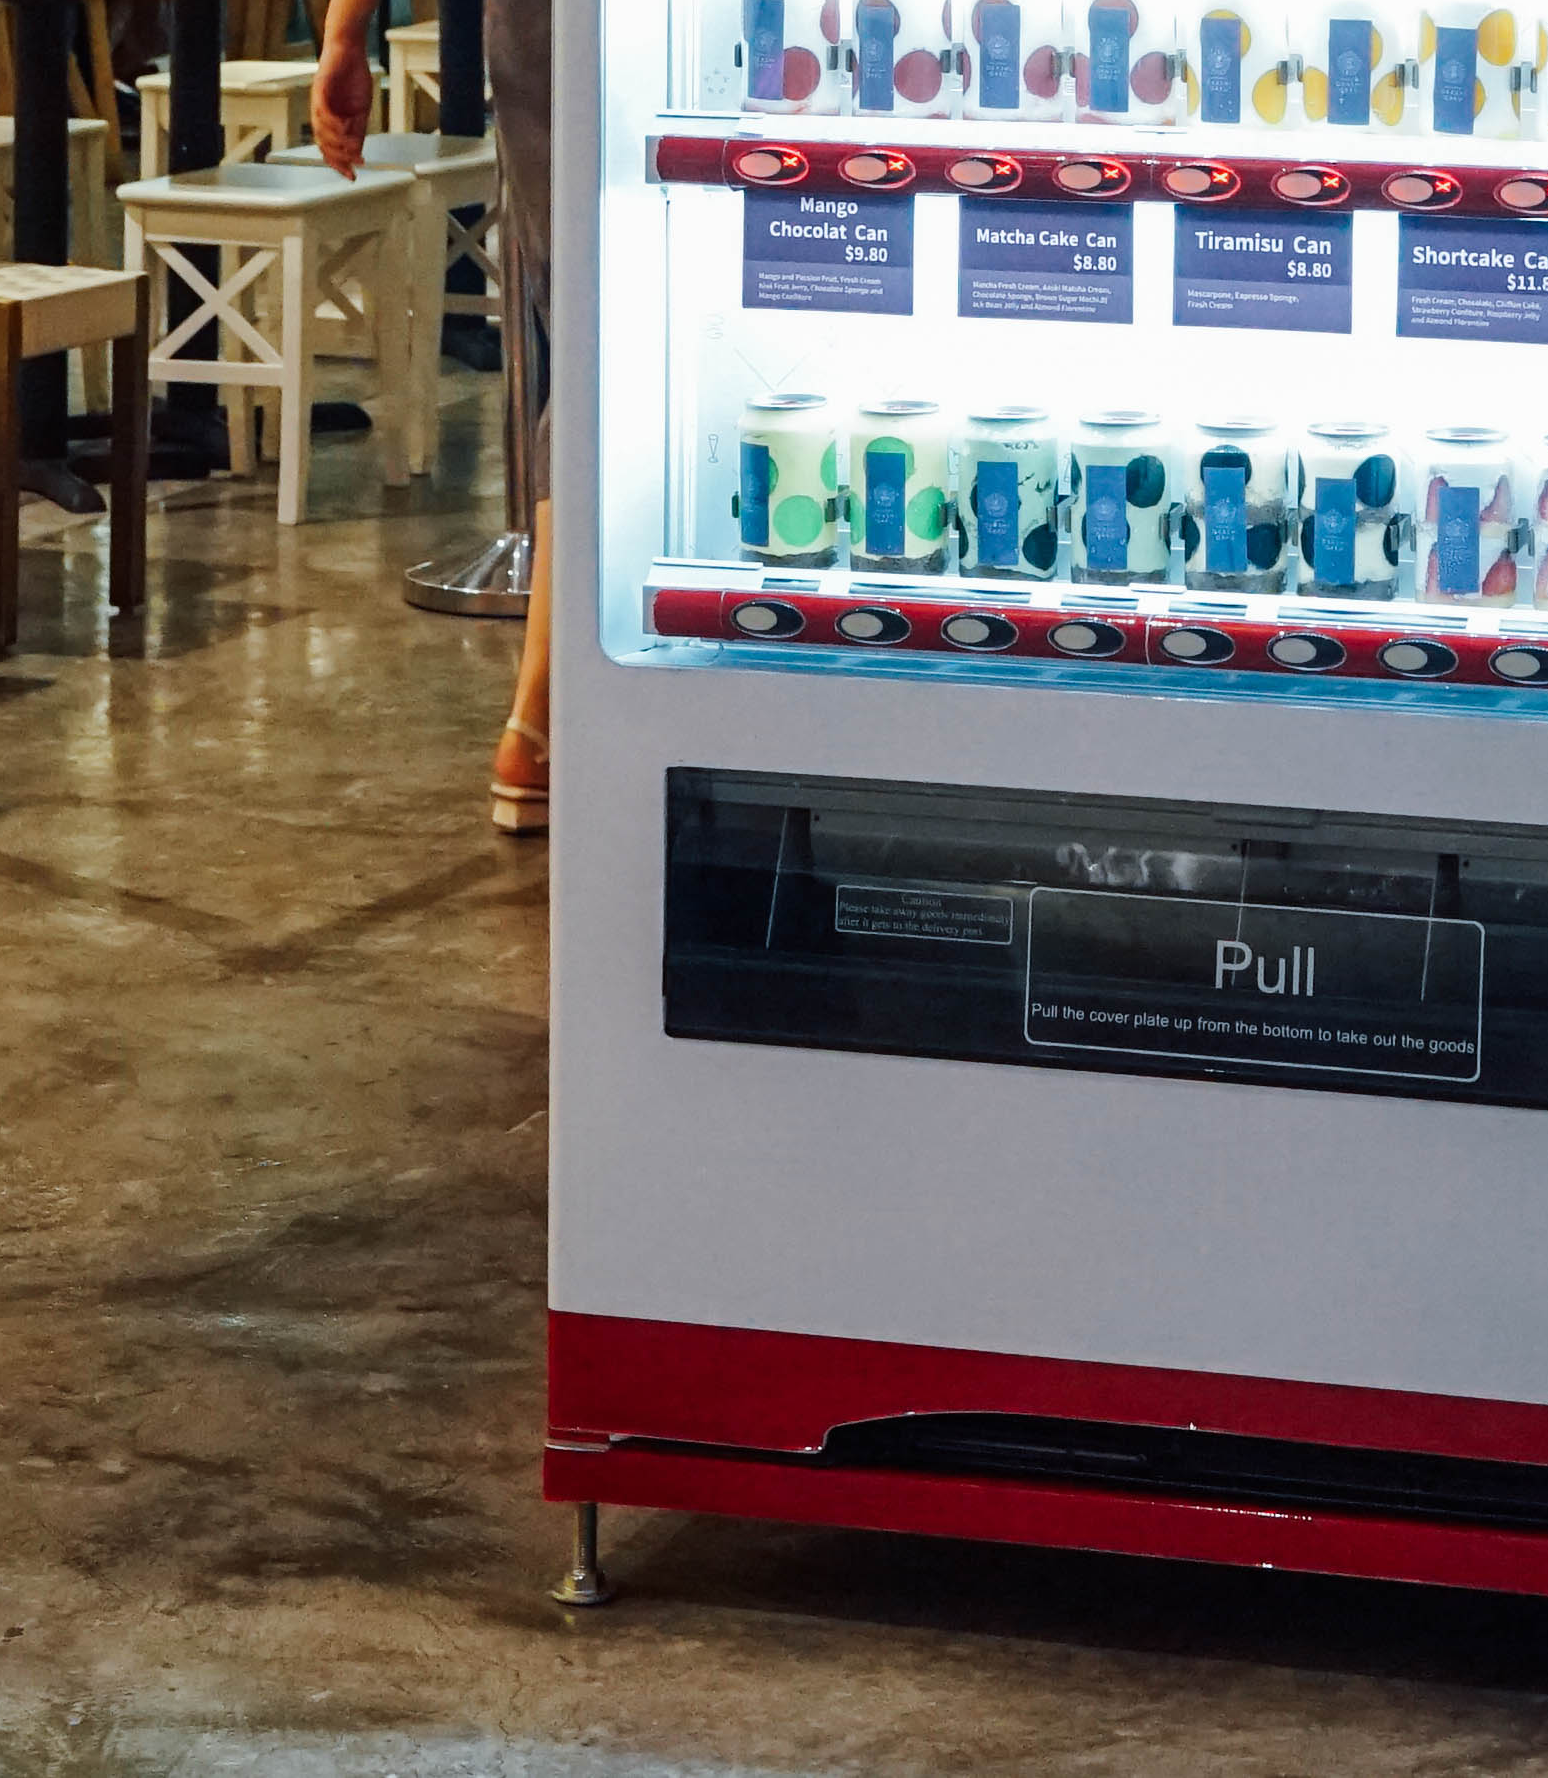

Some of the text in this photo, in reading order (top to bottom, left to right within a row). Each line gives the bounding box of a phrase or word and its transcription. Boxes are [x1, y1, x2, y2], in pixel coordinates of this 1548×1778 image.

[800, 197, 858, 218] Mango
[769, 221, 888, 242] Chocolat Can
[976, 227, 1117, 249] Matcha Cake Can
[1194, 231, 1332, 254] Tiramisu Can
[845, 245, 888, 264] $9.80
[1073, 255, 1117, 273] $8.80
[1412, 246, 1515, 269] Shortcake
[1287, 261, 1332, 279] $8.80
[1215, 939, 1316, 997] Pull
[1031, 1002, 1475, 1055] Pull the cover plate up from the bottom to take out the goods
